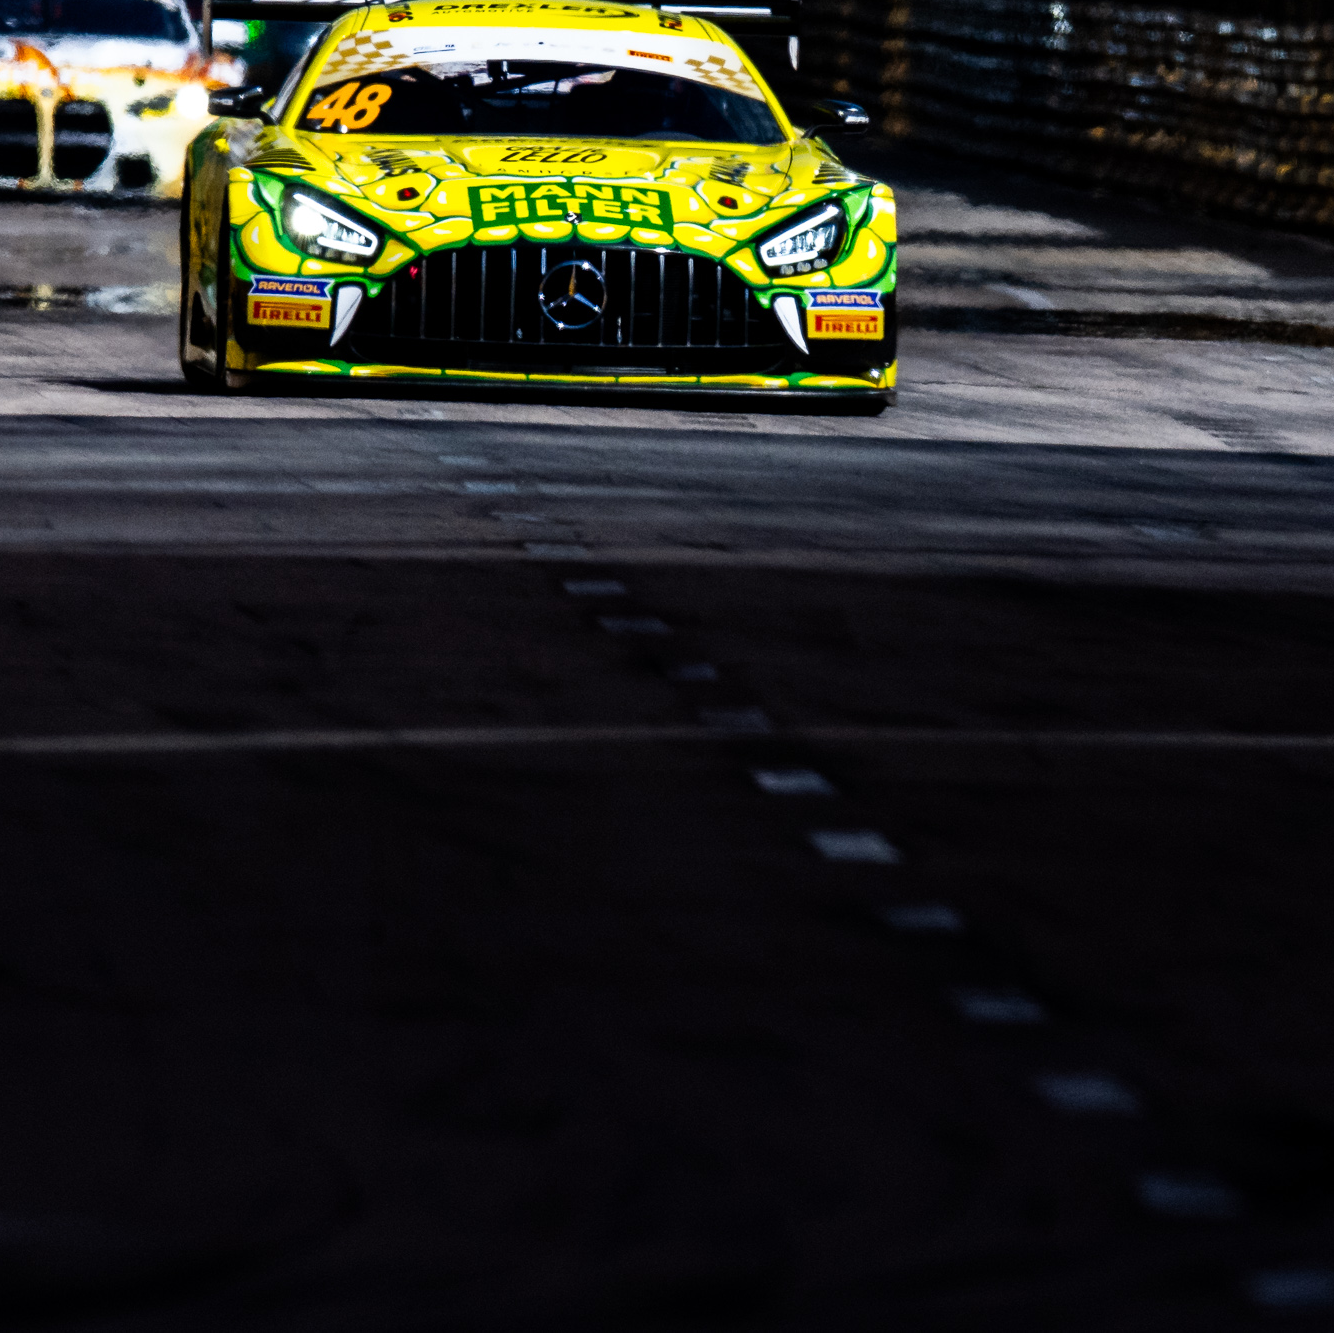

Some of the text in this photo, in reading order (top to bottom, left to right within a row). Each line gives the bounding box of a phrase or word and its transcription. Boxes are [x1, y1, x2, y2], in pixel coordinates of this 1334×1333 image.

[433, 3, 607, 15] DREXLER
[306, 81, 392, 129] 48
[479, 184, 660, 205] MANN
[482, 198, 664, 225] FILTER
[258, 281, 320, 294] RAVENOL
[816, 294, 874, 305] RAVENOL
[253, 301, 323, 322] PIRELLI
[815, 315, 878, 333] PIRELLI
